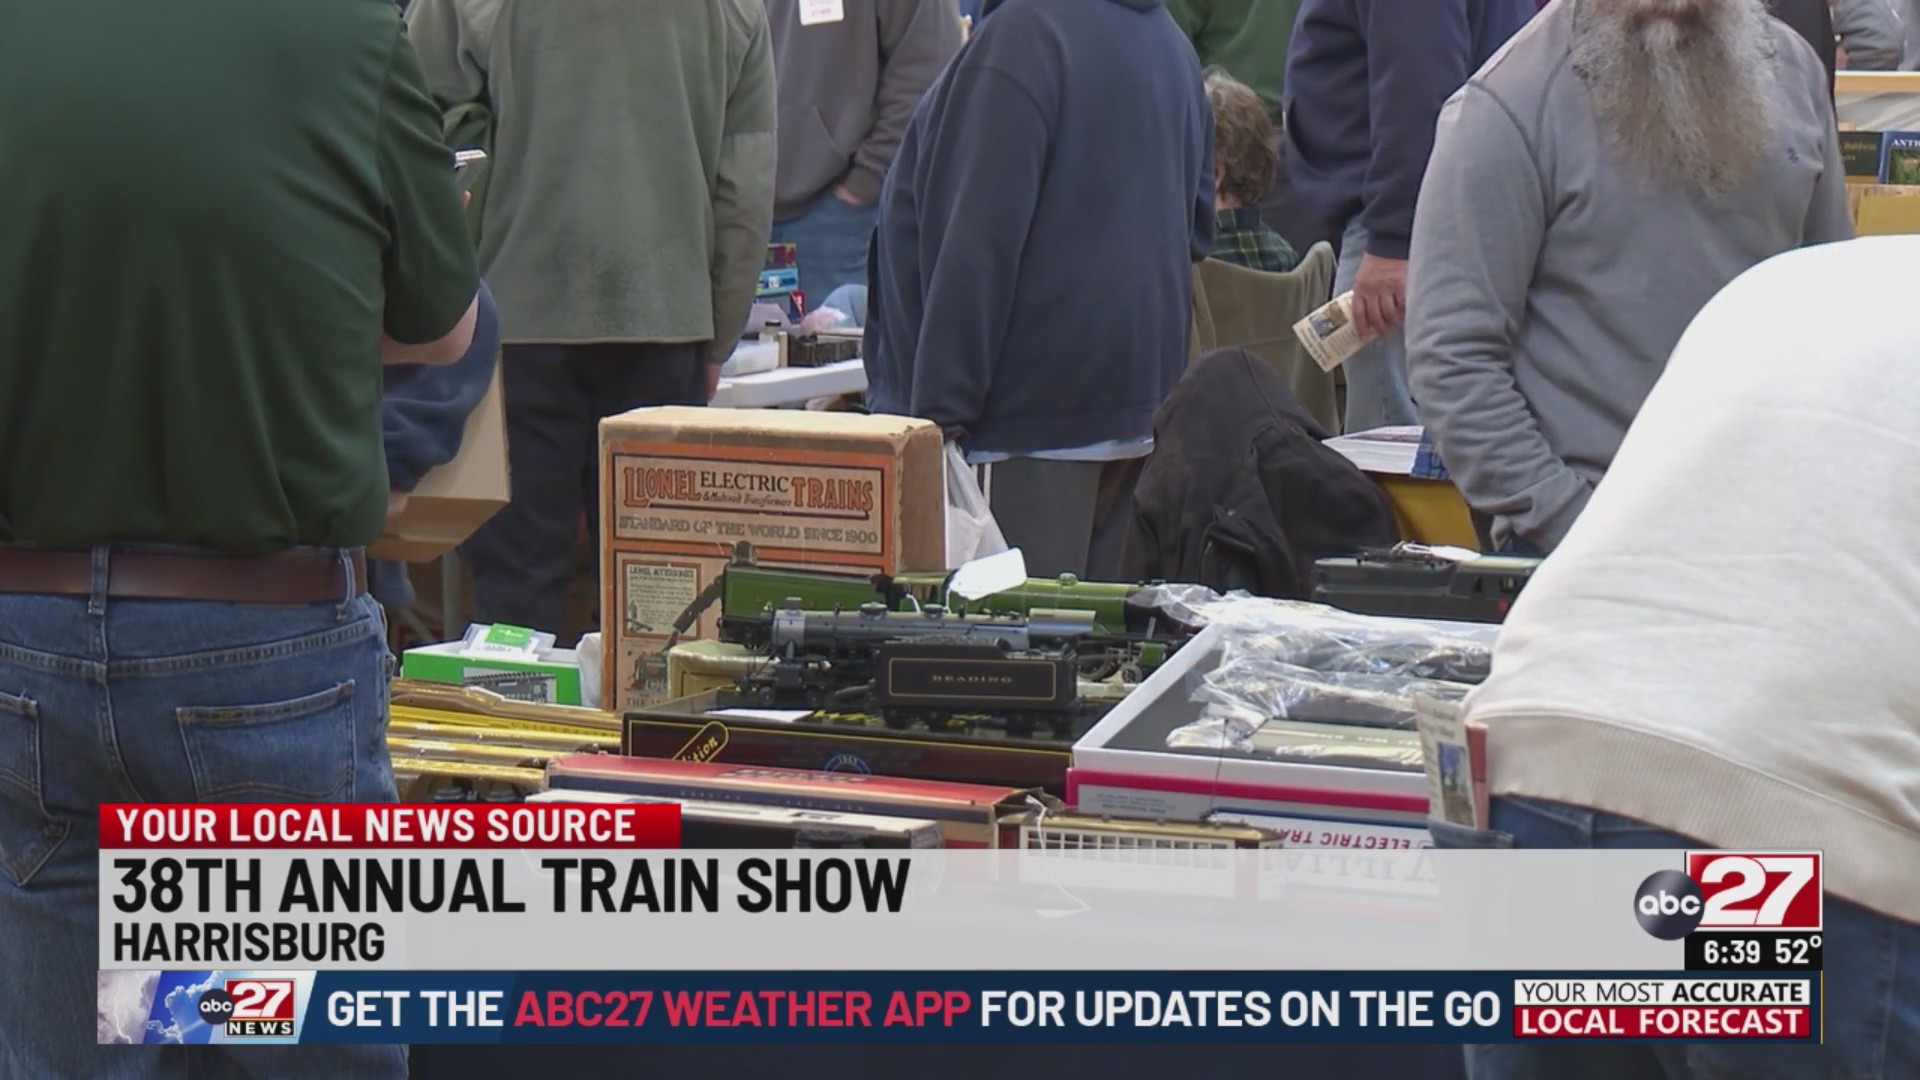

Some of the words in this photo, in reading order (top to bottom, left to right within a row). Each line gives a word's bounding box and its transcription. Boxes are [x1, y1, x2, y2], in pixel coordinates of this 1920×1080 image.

[624, 467, 701, 508] LIONEL
[700, 470, 789, 493] ELECTRIC
[791, 476, 873, 512] TRAINS
[619, 515, 691, 532] STANDARD
[693, 520, 712, 534] OF
[714, 521, 745, 536] THE
[747, 523, 801, 539] WORLD
[803, 527, 843, 542] SINCE
[844, 529, 878, 544] 1900
[933, 674, 1013, 684] READING
[1320, 831, 1411, 850] ELECTRIC
